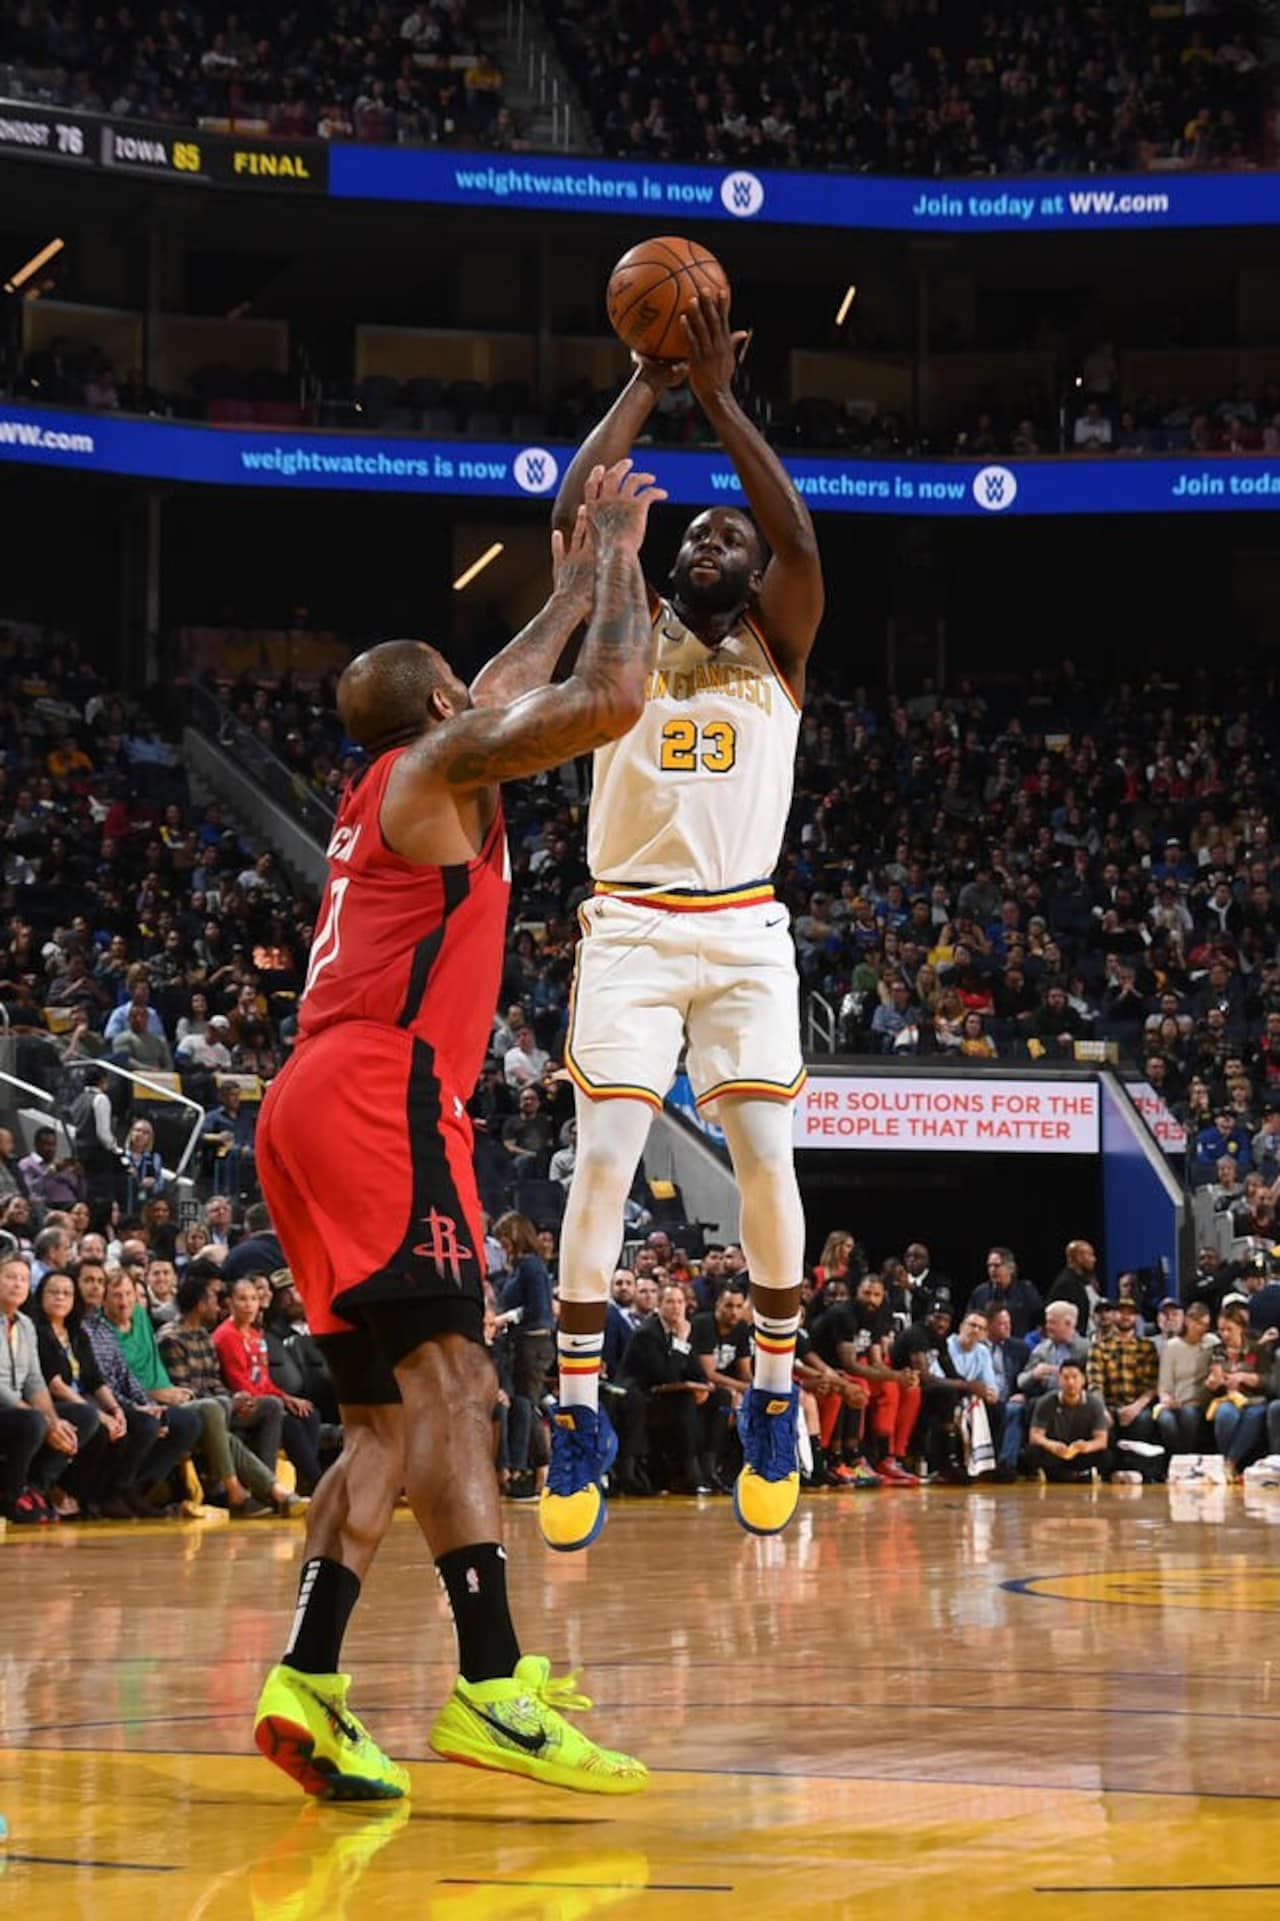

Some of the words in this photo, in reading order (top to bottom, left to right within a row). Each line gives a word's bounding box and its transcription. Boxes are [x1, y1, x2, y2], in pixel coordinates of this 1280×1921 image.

[56, 124, 83, 154] 76
[115, 136, 167, 164] IOWA
[173, 142, 200, 171] 85
[234, 153, 309, 178] FINAL
[455, 168, 637, 198] weightwatchers
[643, 177, 662, 199] is
[667, 182, 713, 203] now
[913, 194, 963, 216] Join
[969, 194, 1034, 220] today
[1040, 194, 1064, 215] at
[1070, 191, 1169, 215] WW.com
[241, 448, 429, 475] weightwatchers
[434, 456, 453, 476] is
[458, 461, 507, 480] now
[895, 477, 914, 499] is
[918, 482, 966, 499] now
[1172, 473, 1224, 496] Join
[1229, 472, 1280, 496] toda
[660, 719, 737, 773] 23
[805, 1092, 839, 1110] HR
[847, 1092, 985, 1114] SOLUTIONS
[991, 1096, 1041, 1114] FOR
[1046, 1096, 1094, 1115] THE
[806, 1116, 898, 1137] PEOPLE
[907, 1118, 968, 1137] THAT
[976, 1120, 1071, 1140] MATTER
